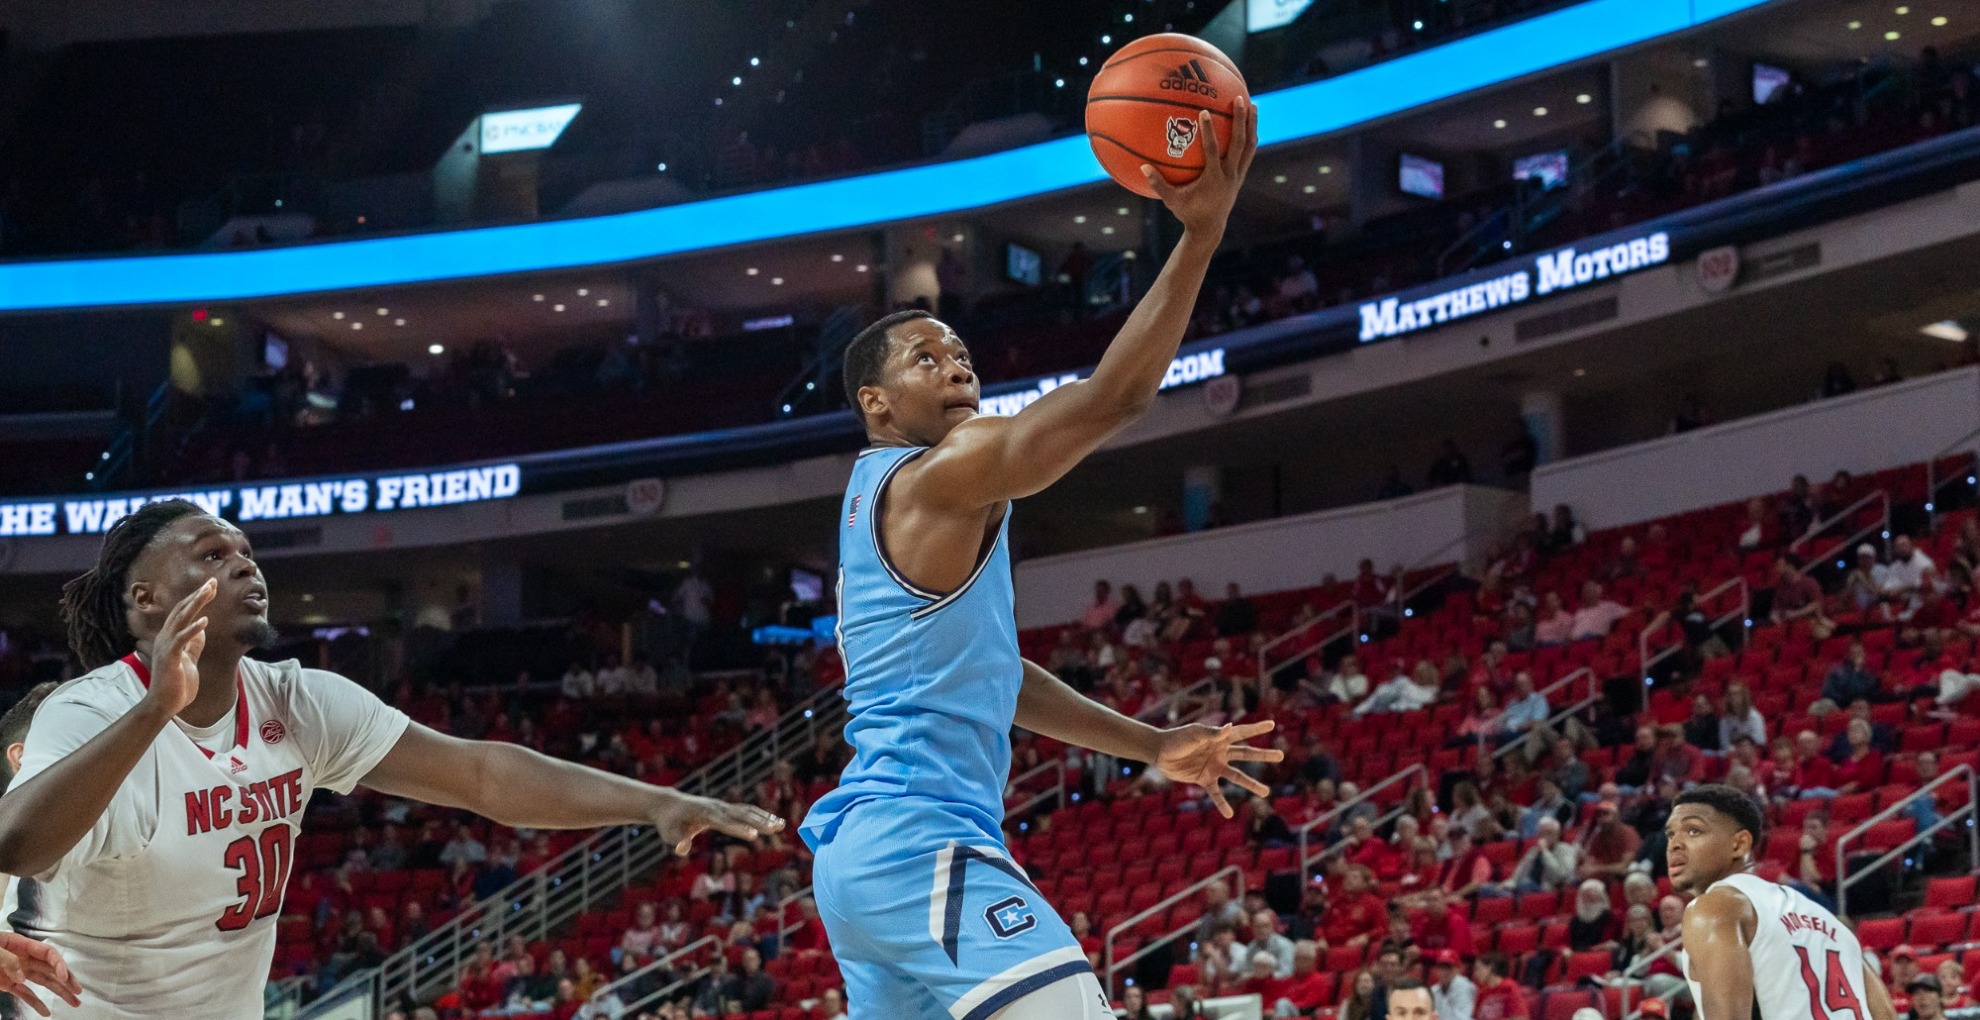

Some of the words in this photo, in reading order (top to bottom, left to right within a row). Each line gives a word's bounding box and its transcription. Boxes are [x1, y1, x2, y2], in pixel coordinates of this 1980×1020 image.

[1160, 77, 1218, 99] adidas
[1358, 269, 1530, 342] MATTHEWS
[1535, 232, 1670, 294] MOTORS
[239, 478, 369, 521] MAN'S
[375, 464, 520, 511] FRIEND
[184, 784, 233, 836] NC
[238, 767, 303, 825] STATE
[215, 823, 291, 932] 30
[1792, 944, 1866, 1020] 14
